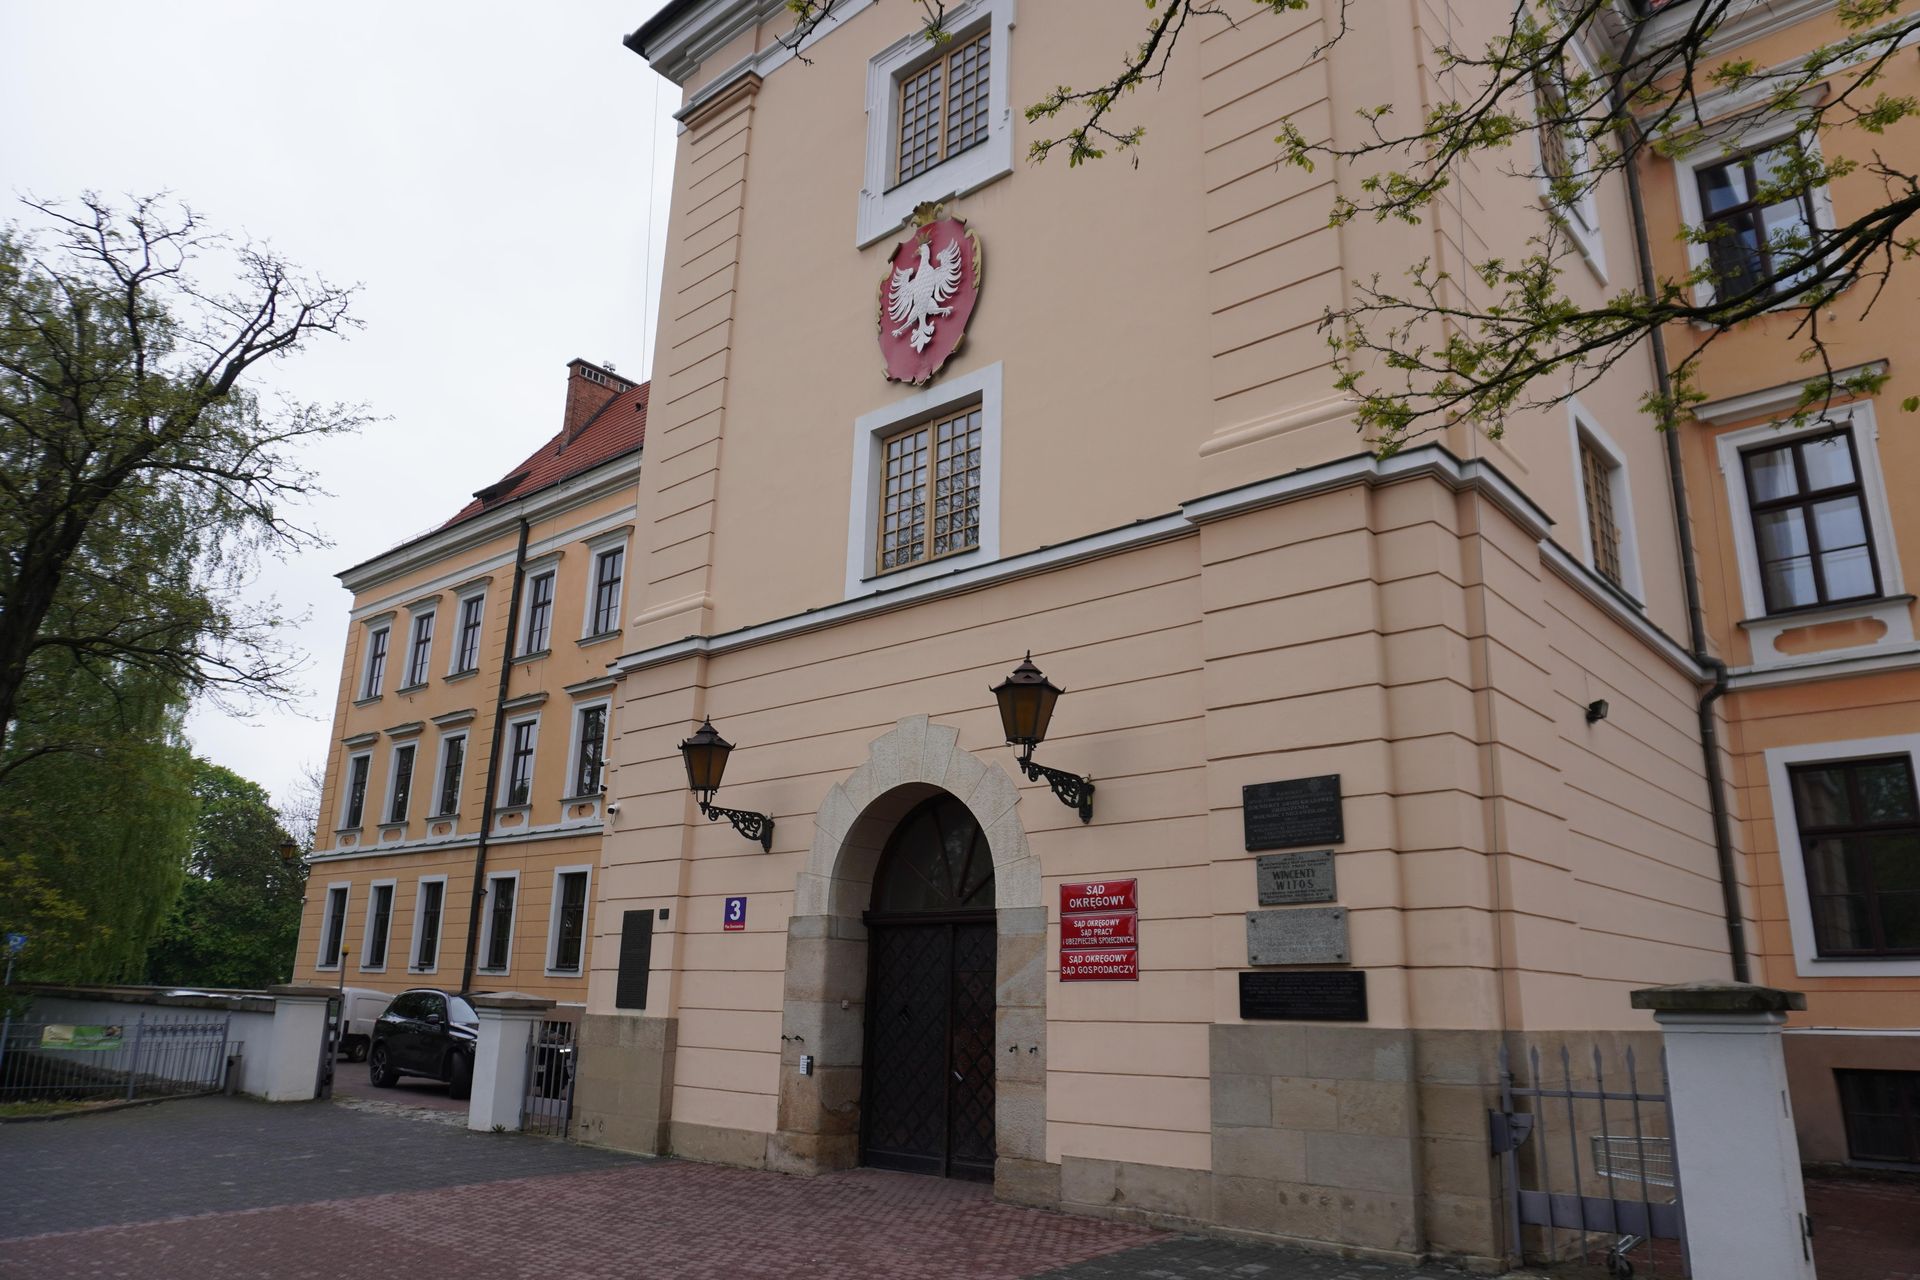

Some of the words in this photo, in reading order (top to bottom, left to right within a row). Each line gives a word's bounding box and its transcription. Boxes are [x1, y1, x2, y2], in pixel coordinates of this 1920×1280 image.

[1272, 869, 1315, 880] WINCENTY
[1276, 880, 1314, 890] WITOS
[1086, 886, 1104, 896] SĄD
[1069, 896, 1124, 908] OKRĘGOWY
[730, 900, 741, 920] 3
[1087, 919, 1119, 928] OKRĘGOWY
[1093, 928, 1113, 936] PRACY
[1069, 955, 1083, 965] SĄD
[1085, 954, 1127, 964] OKRĘGOWY
[1062, 966, 1076, 976] SĄD
[1077, 965, 1135, 974] GOSPODARCZY
